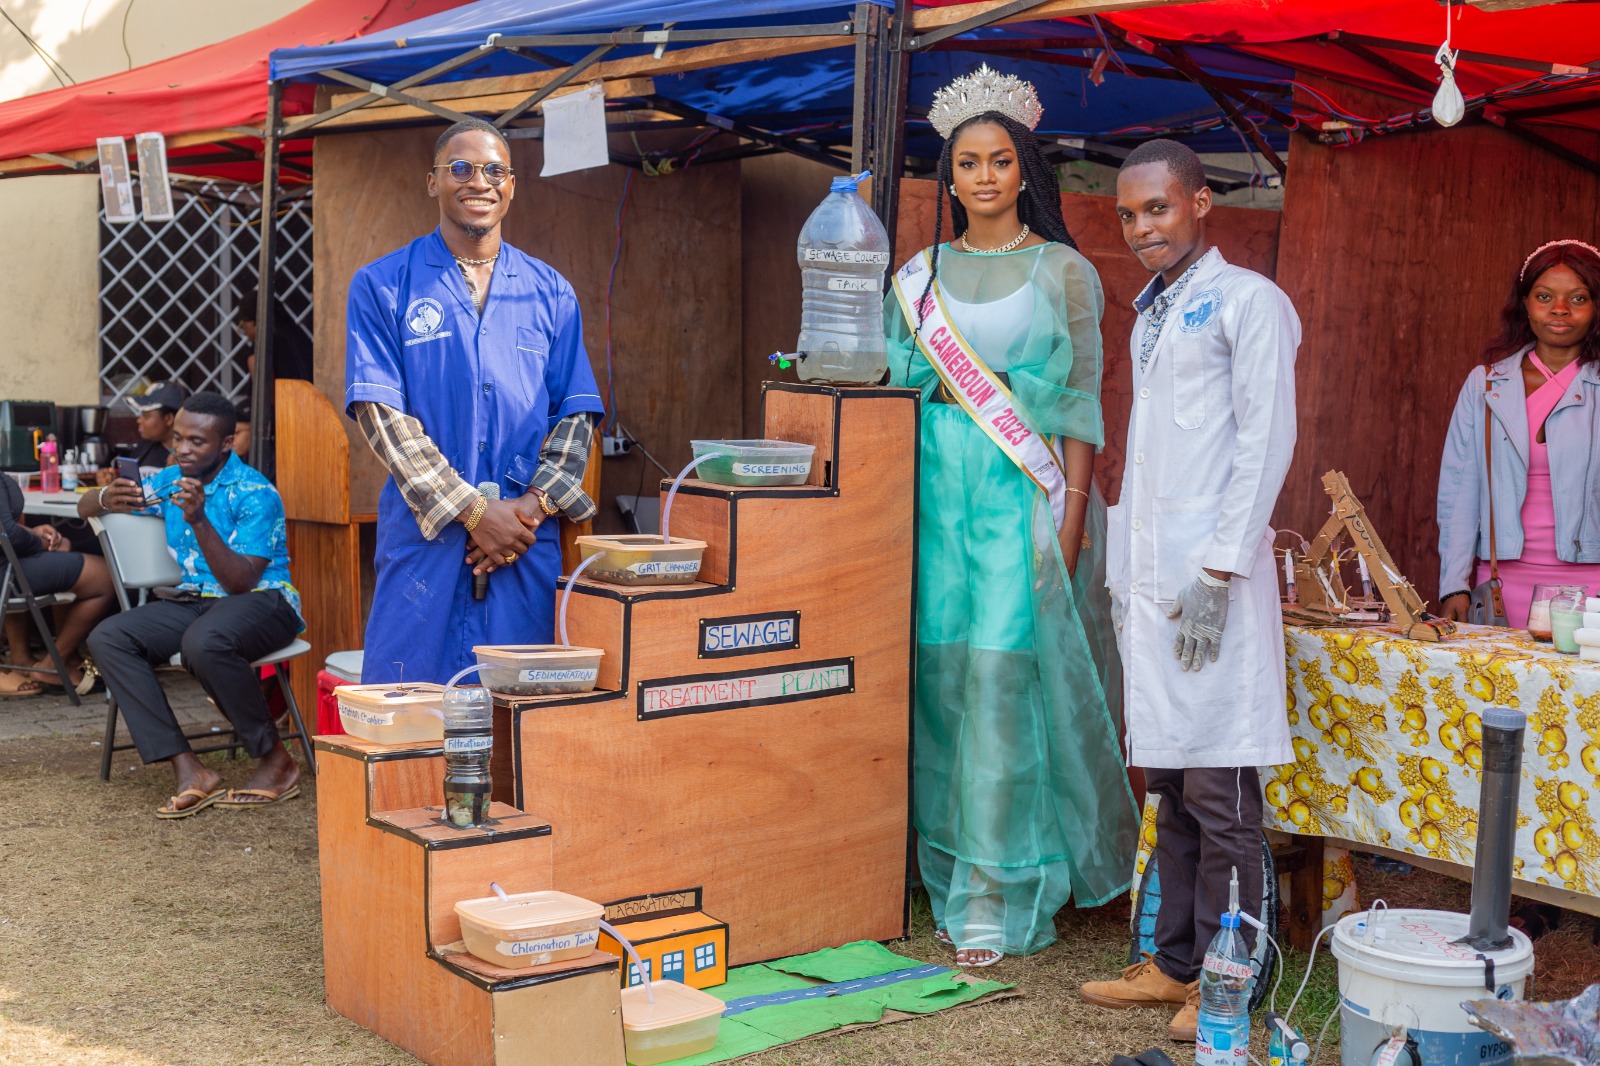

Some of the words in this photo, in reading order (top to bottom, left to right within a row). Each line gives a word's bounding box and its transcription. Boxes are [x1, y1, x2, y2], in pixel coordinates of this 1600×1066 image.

[808, 249, 850, 262] SEWAGE
[836, 279, 869, 291] TANK
[929, 326, 997, 408] CAMEROUN
[991, 407, 1033, 447] 2023
[742, 464, 806, 474] SCREENING
[638, 563, 661, 574] GRIT
[664, 562, 698, 572] CHAMBER
[706, 619, 791, 651] SEWAGE
[528, 670, 594, 681] SEDIMENTATION
[645, 680, 757, 710] TREATMENT
[781, 668, 845, 695] PLANT
[448, 738, 485, 750] Filtration
[607, 892, 688, 919] LABORATORY
[511, 936, 570, 955] Chlorination
[575, 933, 595, 948] Tank
